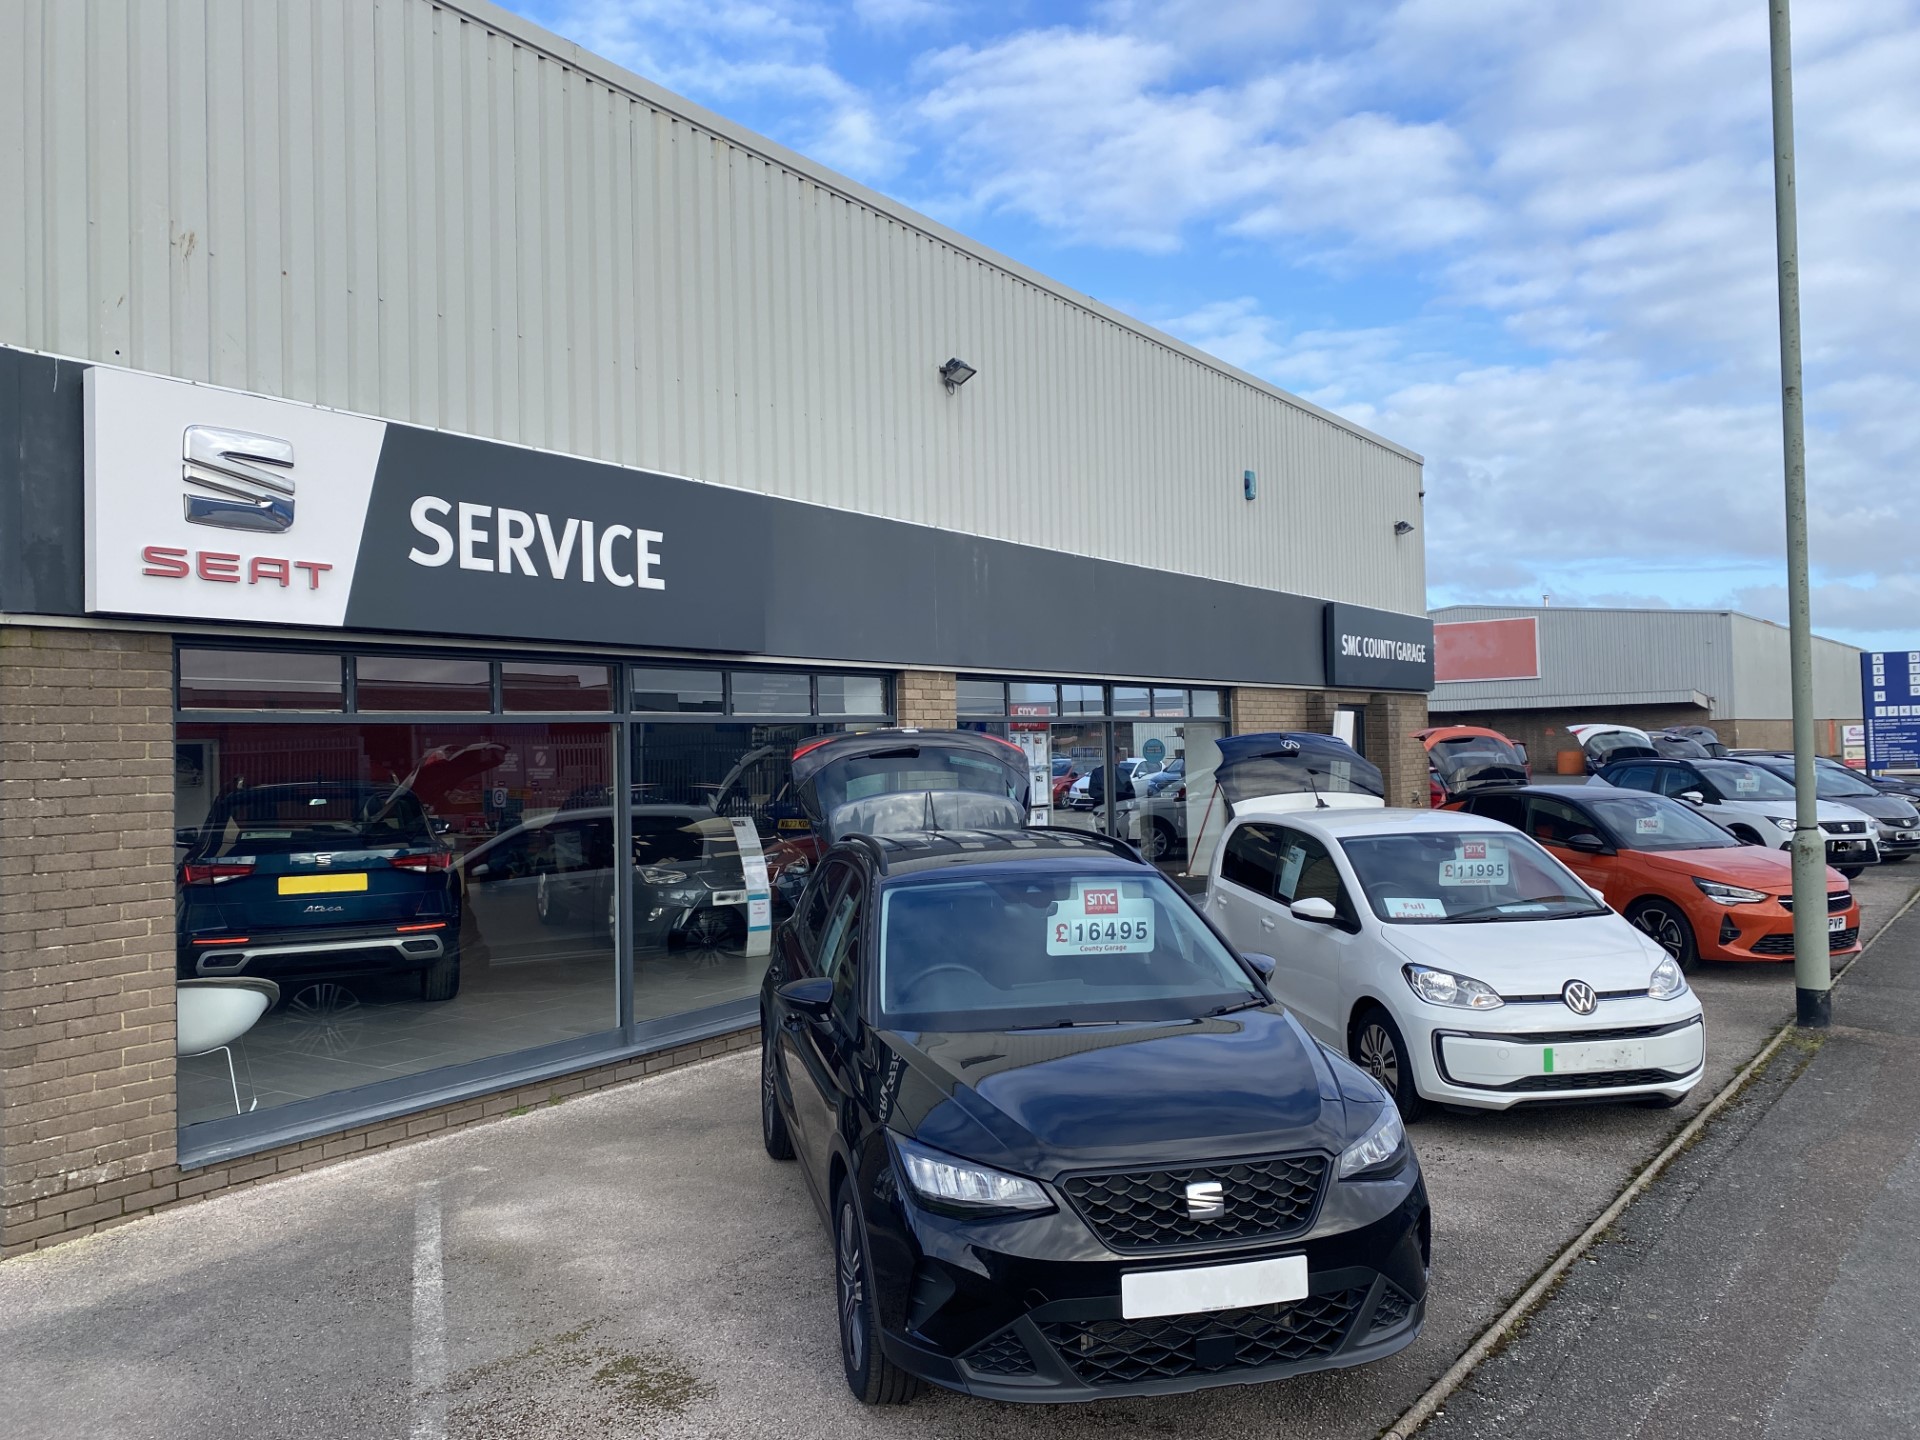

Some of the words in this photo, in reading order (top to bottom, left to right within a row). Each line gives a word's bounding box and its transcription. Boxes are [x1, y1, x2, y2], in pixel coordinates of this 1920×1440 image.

[408, 495, 666, 590] SERVICE
[141, 546, 333, 590] SEAT
[1341, 634, 1362, 657] SMC
[1363, 637, 1396, 660] COUNTY
[1396, 642, 1426, 663] GARAGE
[1643, 819, 1659, 828] SOLD
[1087, 893, 1116, 905] smc
[303, 905, 343, 913] Ateca
[1403, 902, 1426, 910] Full
[1080, 945, 1103, 953] County
[1104, 944, 1127, 953] Garage
